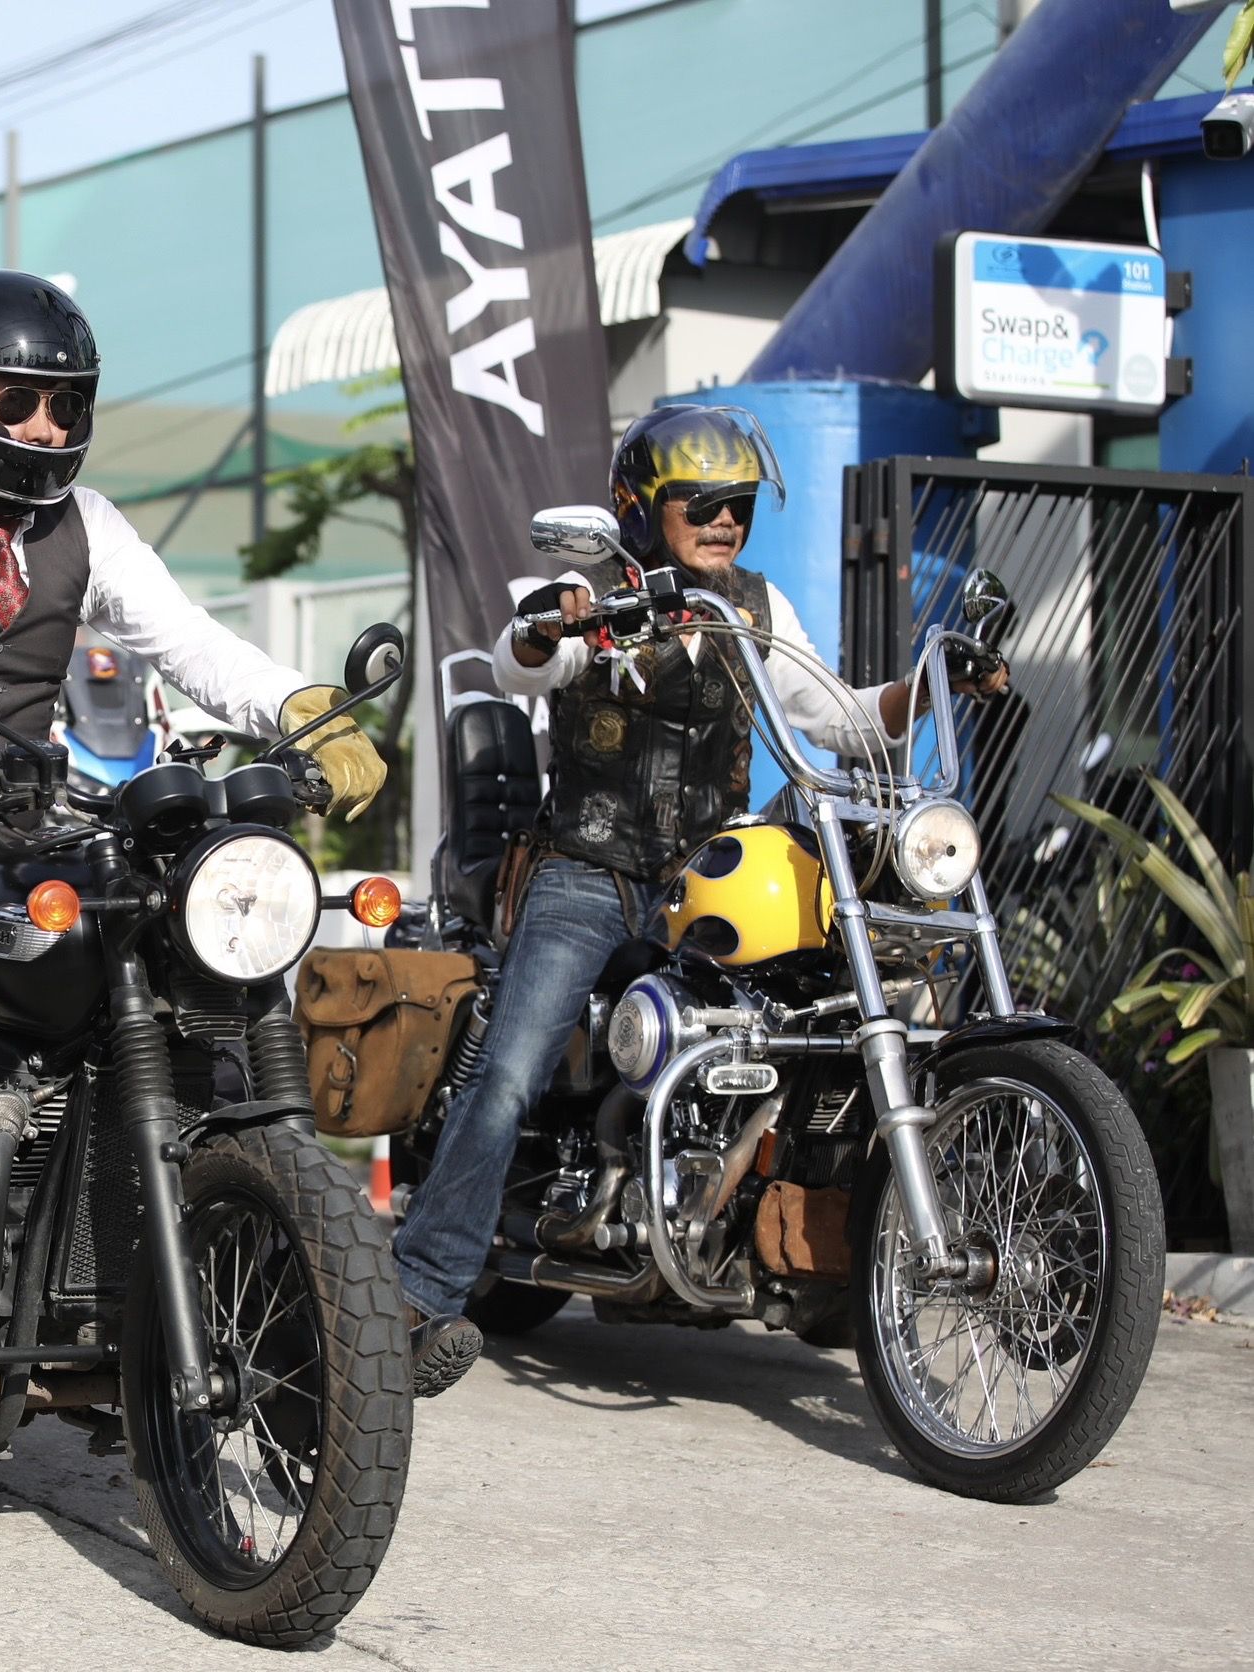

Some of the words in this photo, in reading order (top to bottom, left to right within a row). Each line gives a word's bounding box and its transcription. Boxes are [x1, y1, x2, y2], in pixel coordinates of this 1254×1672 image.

[1123, 261, 1151, 281] 101
[981, 308, 1069, 344] Swap&
[981, 338, 1074, 373] Charge
